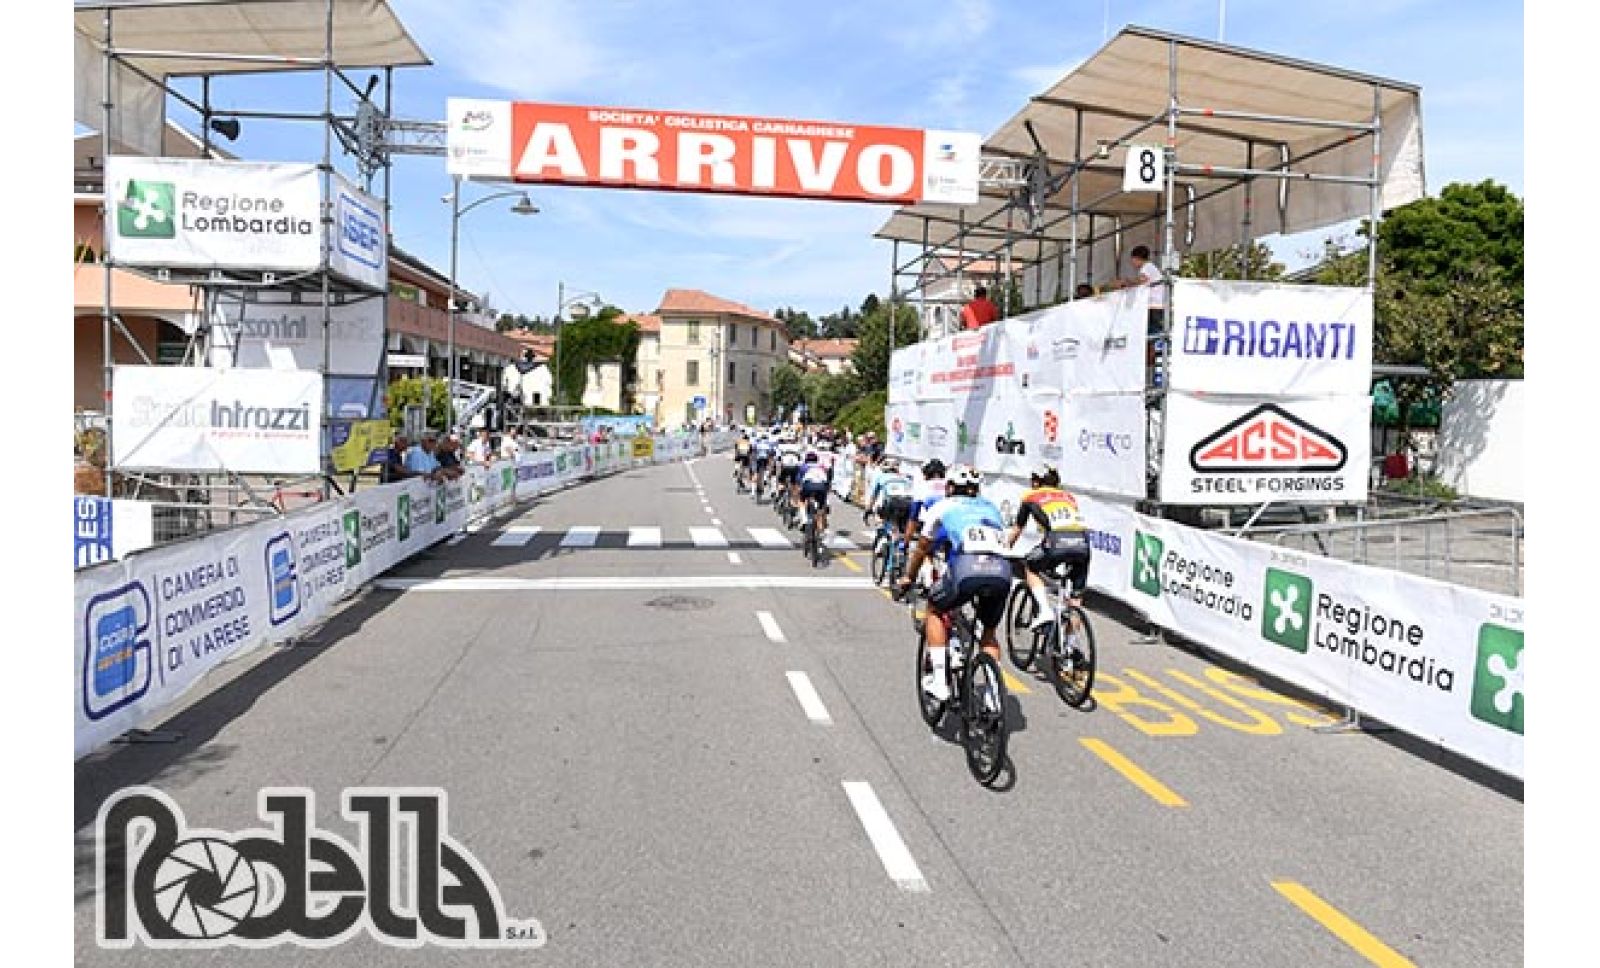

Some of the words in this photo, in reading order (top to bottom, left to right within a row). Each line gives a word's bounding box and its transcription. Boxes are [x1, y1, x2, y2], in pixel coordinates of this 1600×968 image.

[664, 115, 749, 131] CICLISTICA
[513, 119, 916, 197] ARRIVO
[1139, 149, 1156, 184] 8
[181, 191, 285, 216] Regione
[181, 213, 313, 236] Lombardia
[1222, 319, 1356, 360] RIGANTI
[1199, 419, 1340, 461] ACSA
[1254, 476, 1344, 493] FORGINGS
[968, 527, 987, 542] 61
[162, 560, 225, 601] CAMERA
[225, 555, 240, 578] DI
[1164, 549, 1234, 588] Regione
[165, 585, 247, 638] COMMERCIO
[1160, 571, 1252, 621] Lombardia
[1315, 592, 1424, 647] Regione
[168, 643, 184, 672] DI
[189, 614, 251, 659] VARESE
[1312, 621, 1456, 693] Lombardia
[1090, 665, 1339, 737] BUS
